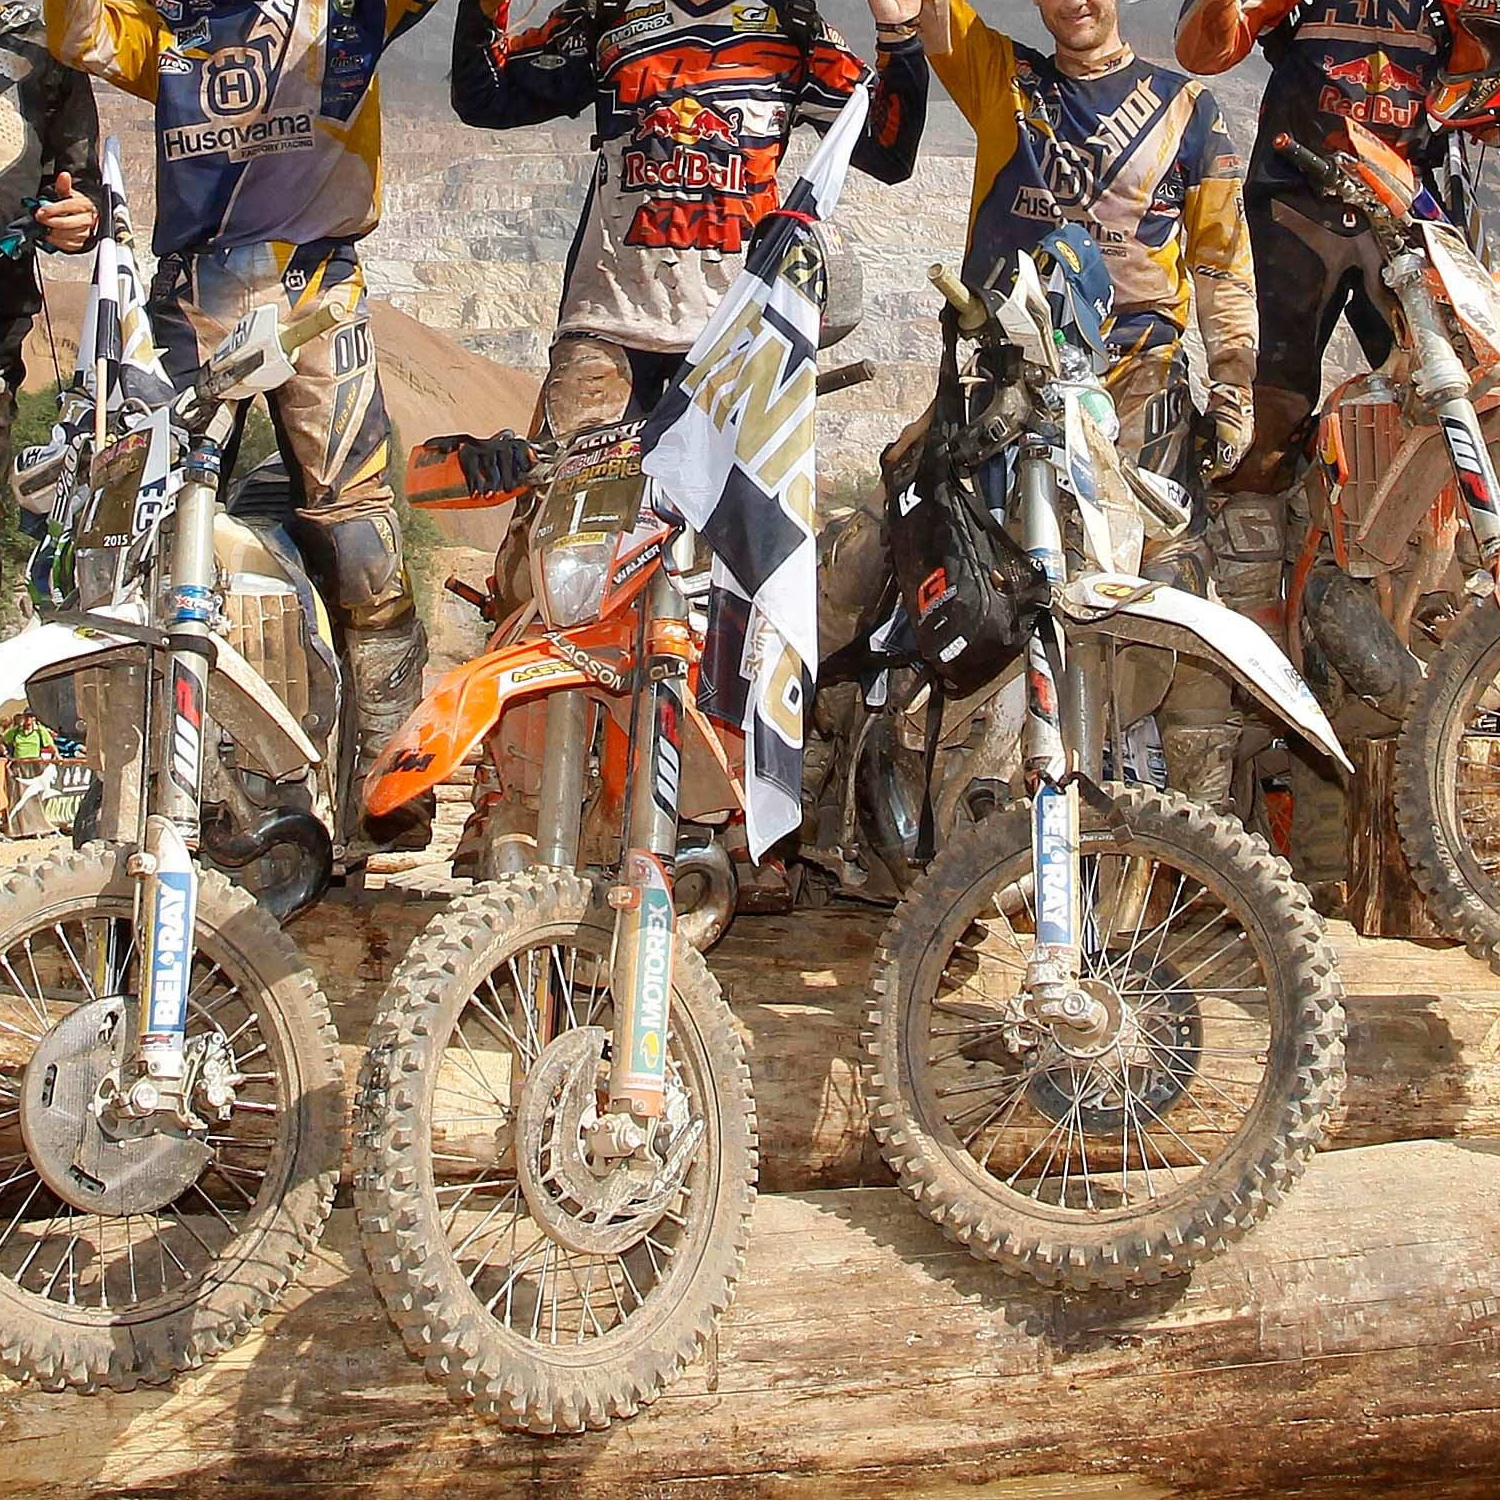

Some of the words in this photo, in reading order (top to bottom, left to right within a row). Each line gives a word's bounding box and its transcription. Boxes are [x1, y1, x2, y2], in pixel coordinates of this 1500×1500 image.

[611, 13, 672, 44] MOTOREX
[1318, 85, 1369, 123] Red
[165, 113, 312, 158] Husqvarna
[626, 145, 684, 188] Red
[685, 150, 747, 194] Bull
[568, 490, 589, 536] 1
[102, 533, 129, 548] 2015
[612, 543, 661, 585] WALKER
[639, 902, 670, 1031] MOTOREX
